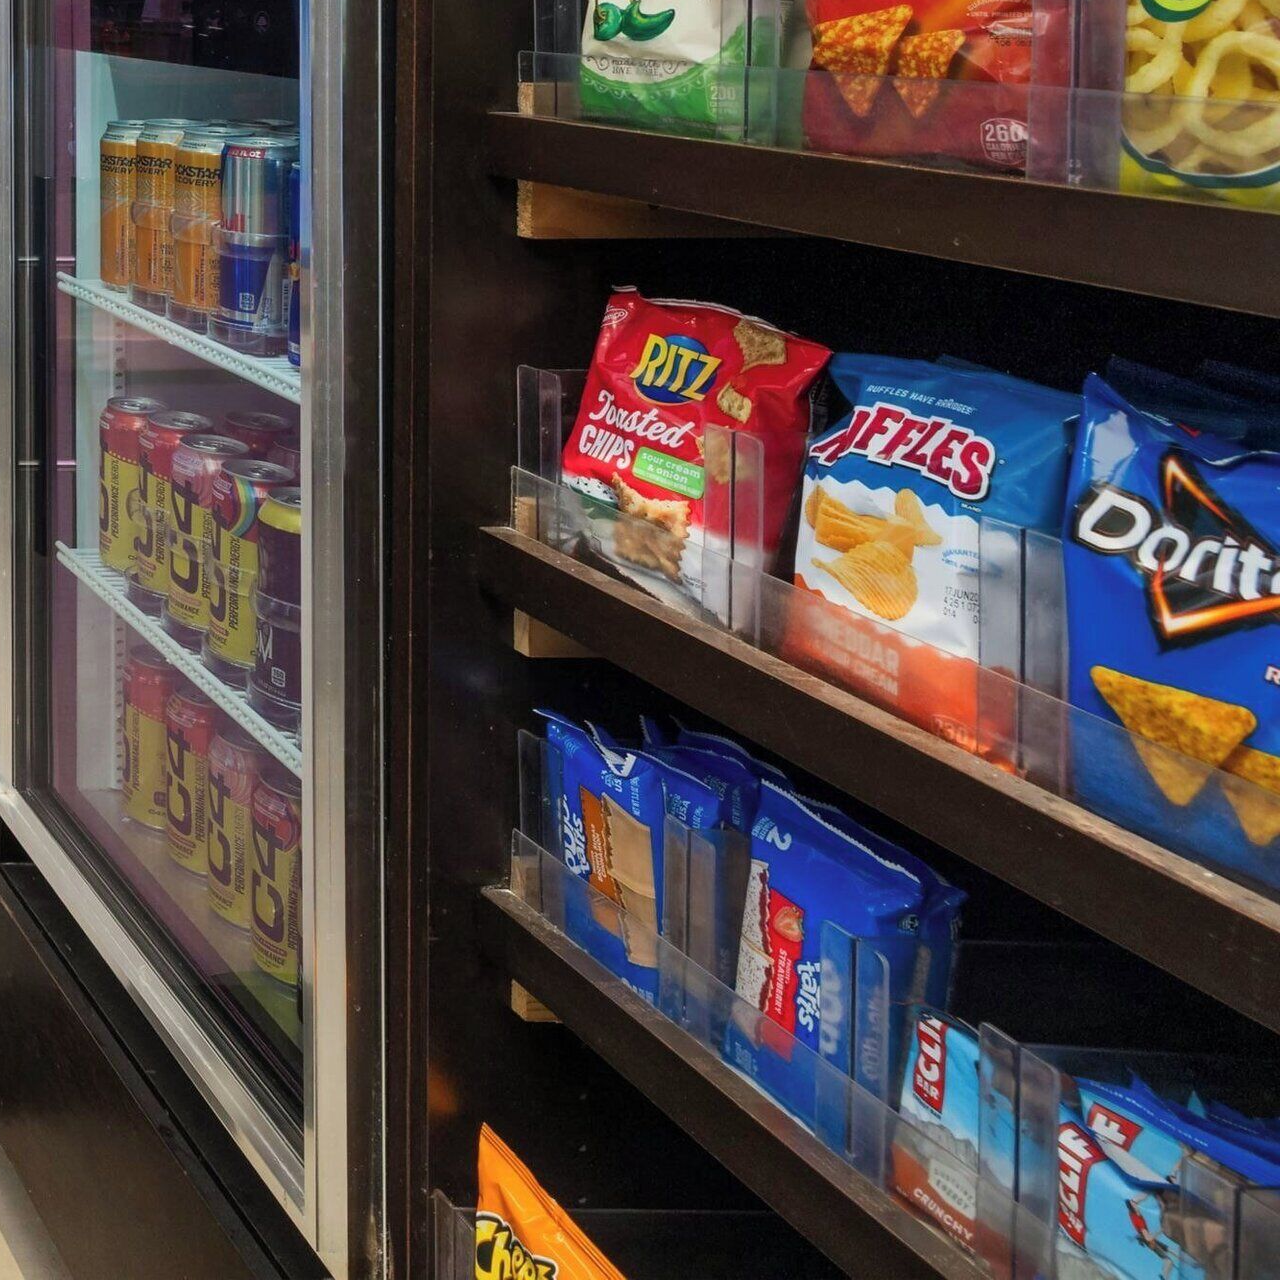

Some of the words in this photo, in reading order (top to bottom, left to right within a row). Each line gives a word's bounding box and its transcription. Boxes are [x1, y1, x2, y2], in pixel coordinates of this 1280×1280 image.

[251, 150, 262, 158] OZ
[985, 123, 1025, 142] 260
[629, 332, 723, 402] RITZ
[866, 384, 909, 399] RUFFLES
[909, 391, 937, 406] HAVE
[589, 389, 695, 449] Toasted
[578, 424, 635, 470] CHIPS
[642, 452, 664, 466] sour
[665, 460, 701, 479] cream
[647, 463, 655, 473] &
[655, 466, 688, 484] onion
[167, 728, 193, 836] C4
[207, 773, 232, 887] C4
[767, 826, 792, 852] 2
[251, 816, 286, 943] C4
[771, 947, 788, 1016] STRAWBERRY
[915, 1075, 940, 1102] BAR
[913, 1187, 974, 1240] CRUNCHY
